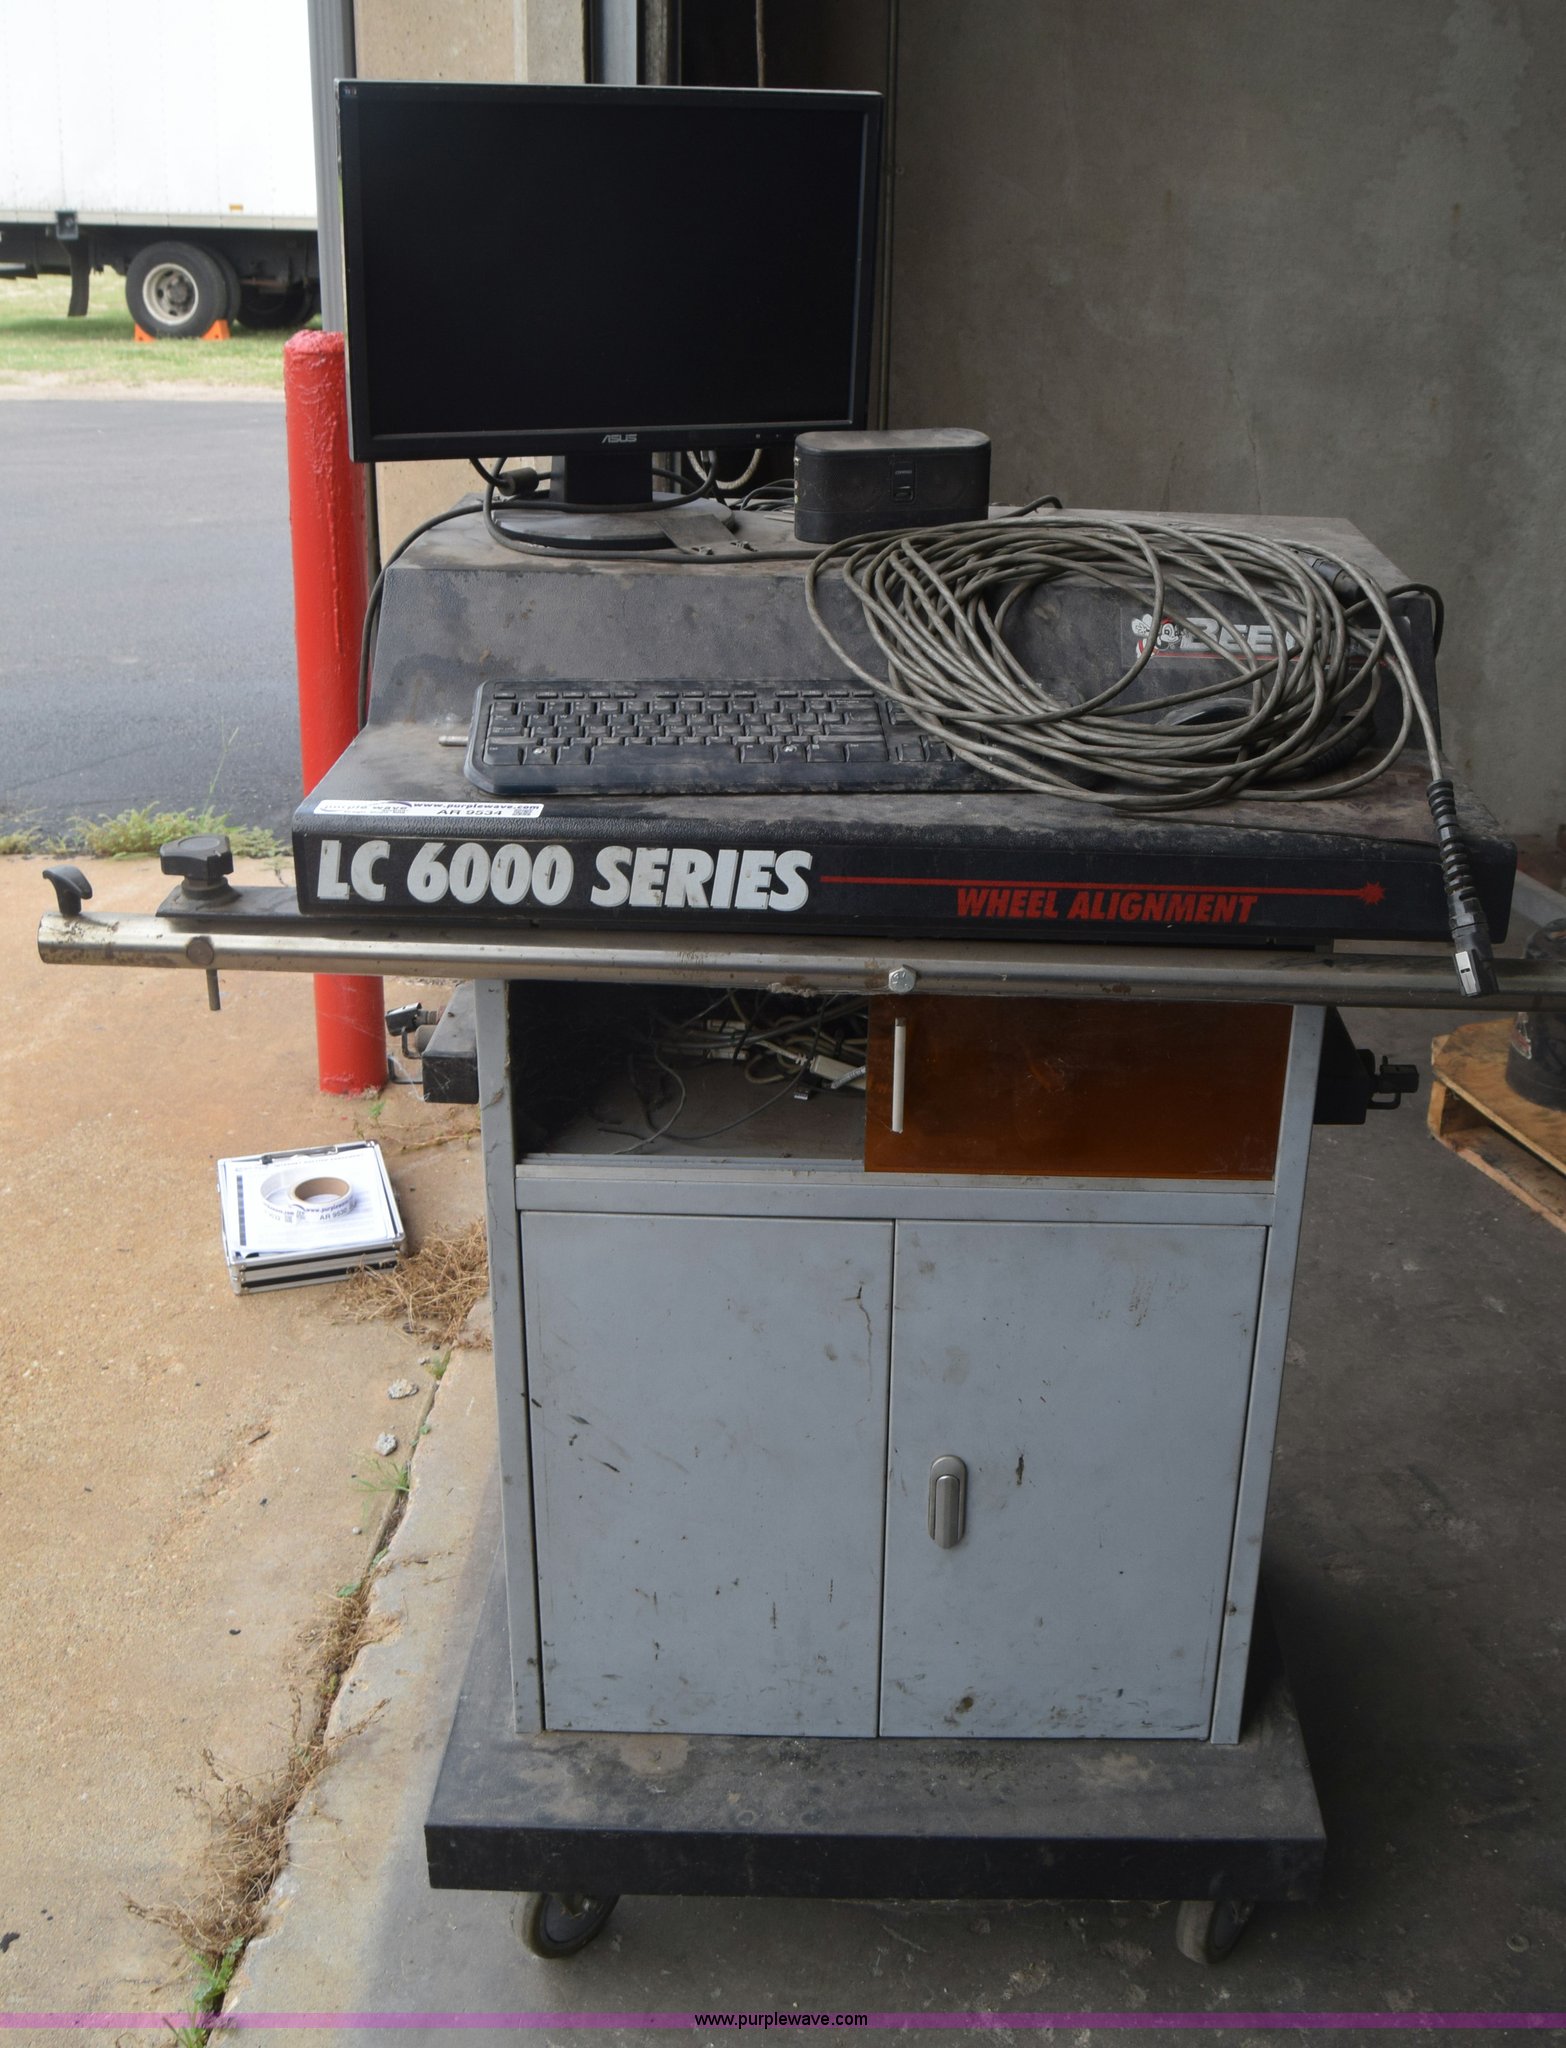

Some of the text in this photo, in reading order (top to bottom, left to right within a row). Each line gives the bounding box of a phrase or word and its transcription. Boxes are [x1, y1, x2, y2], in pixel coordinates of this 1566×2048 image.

[601, 433, 638, 444] ASUS
[413, 802, 540, 811] www.purplewave.com
[465, 809, 503, 817] 9534
[317, 839, 813, 911] LC 6000 SERIES
[956, 888, 1258, 923] WHEEL ALIGNMENT
